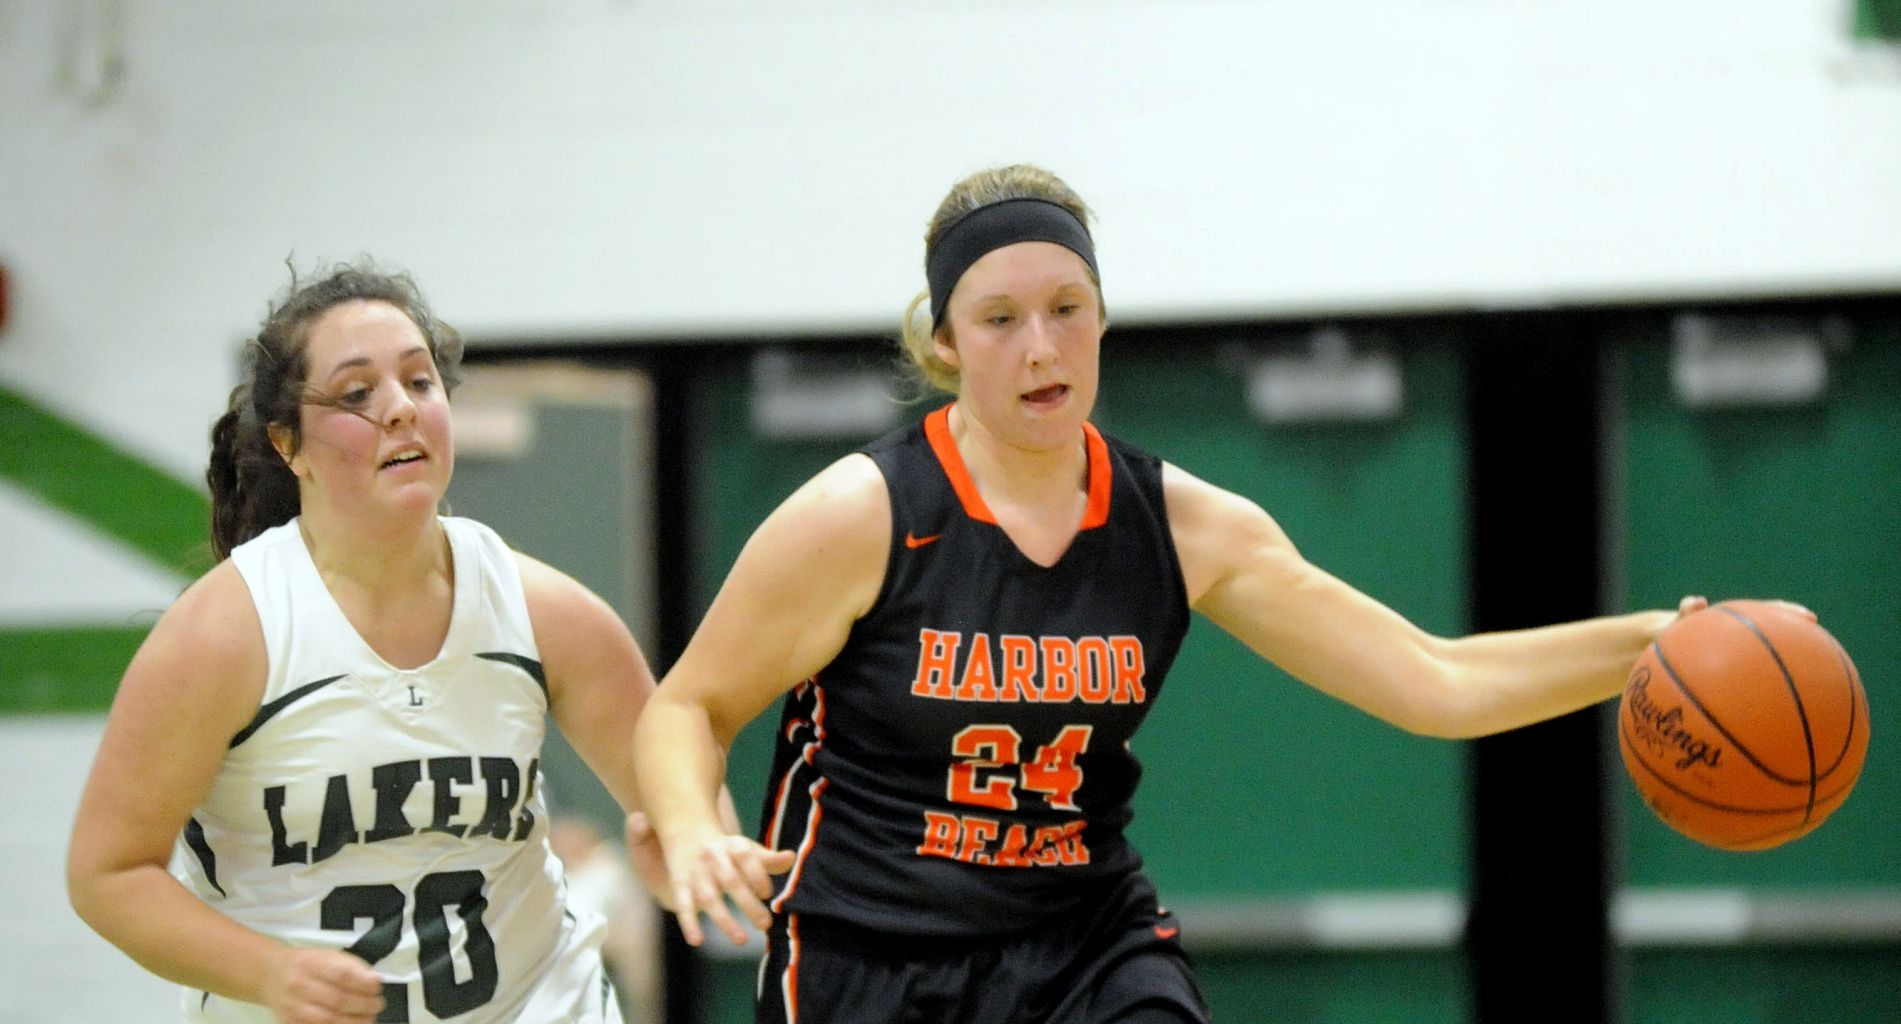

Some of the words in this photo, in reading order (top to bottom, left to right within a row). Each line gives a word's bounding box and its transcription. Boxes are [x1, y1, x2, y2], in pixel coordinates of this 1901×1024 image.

[407, 685, 424, 707] L
[911, 628, 1146, 704] HARBOR
[1628, 666, 1723, 771] Rawlings
[947, 725, 1094, 812] 24
[320, 870, 499, 1024] 20
